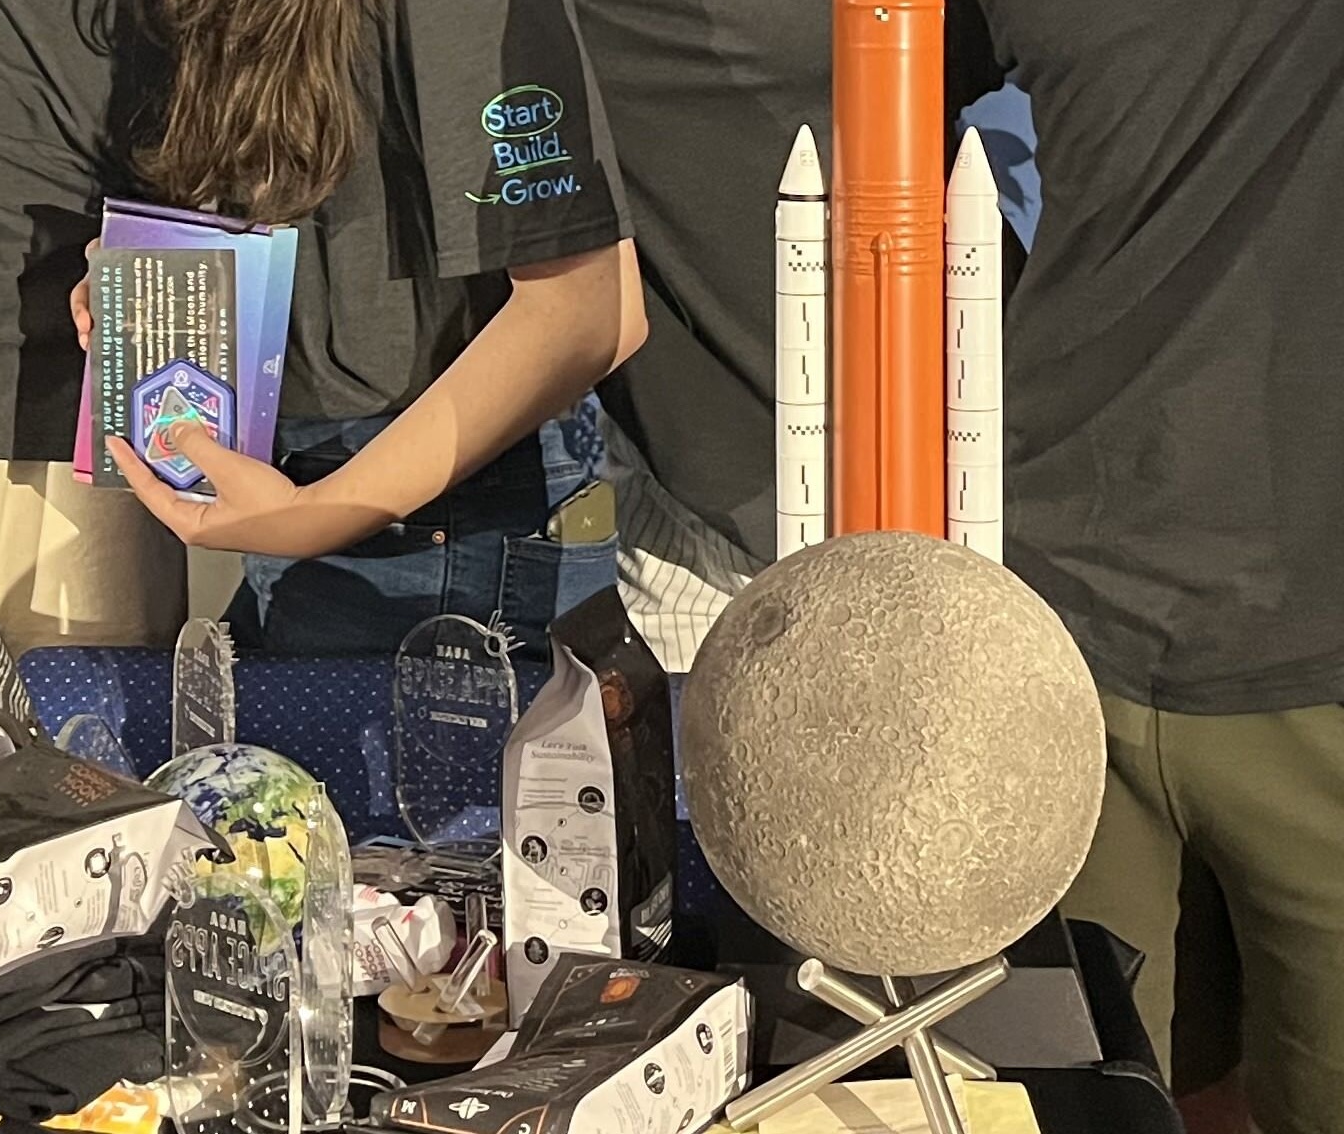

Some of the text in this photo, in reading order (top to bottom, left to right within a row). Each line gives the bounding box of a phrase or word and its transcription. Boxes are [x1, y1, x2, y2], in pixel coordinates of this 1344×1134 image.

[492, 132, 568, 169] Build.
[501, 174, 582, 205] Grow.
[101, 266, 110, 281] be
[185, 271, 196, 292] and
[101, 286, 110, 309] and
[185, 295, 196, 326] Moon
[101, 314, 113, 355] legacy
[186, 329, 196, 348] the
[197, 319, 207, 335] for
[103, 360, 114, 396] space
[114, 337, 124, 390] outward
[103, 401, 114, 430] your
[114, 394, 124, 426] life's
[400, 1099, 417, 1115] M
